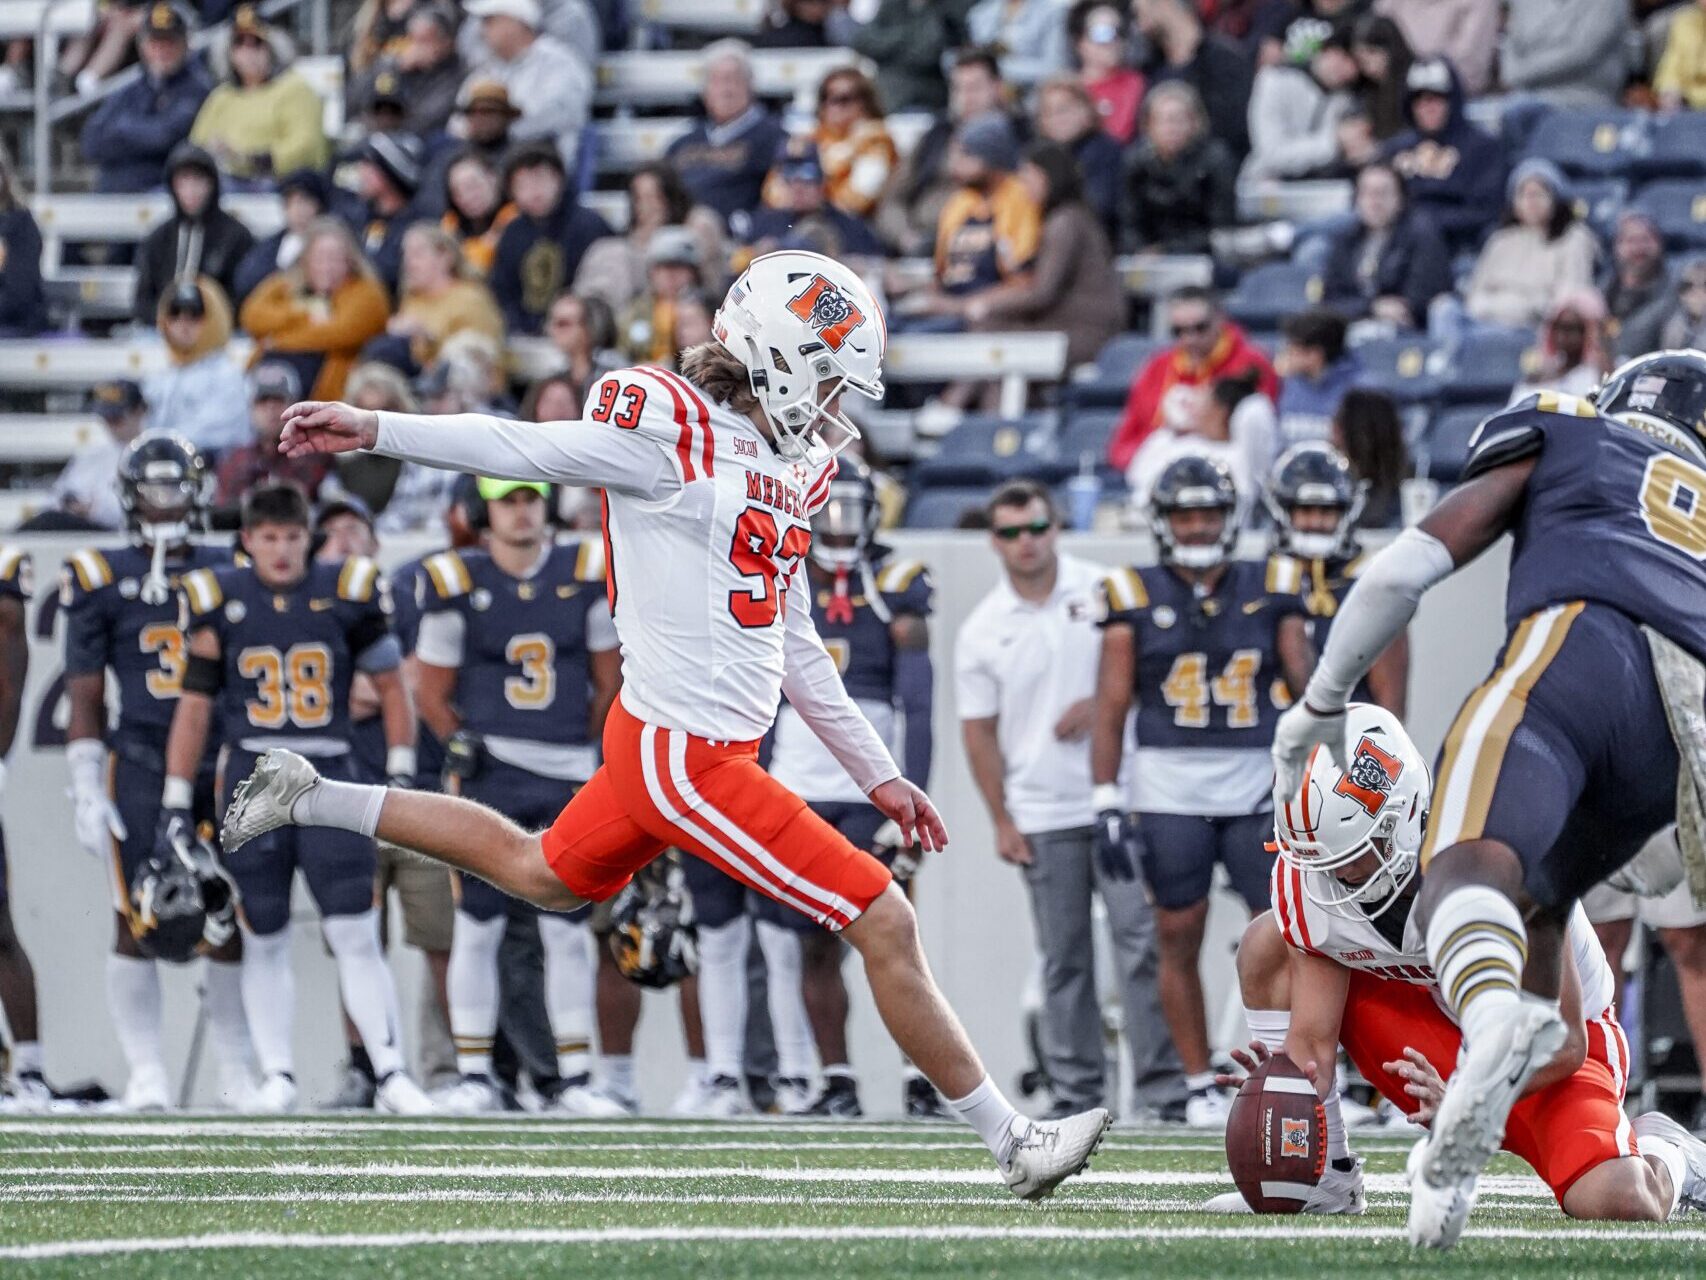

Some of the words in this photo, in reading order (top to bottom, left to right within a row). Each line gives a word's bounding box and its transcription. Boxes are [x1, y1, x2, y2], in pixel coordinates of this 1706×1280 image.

[591, 379, 647, 430] 93
[733, 436, 758, 458] SOCON
[745, 470, 808, 520] MERCE
[238, 642, 334, 729] 38
[504, 632, 557, 710] 3
[1161, 648, 1262, 728] 44
[1340, 949, 1376, 962] SOCON
[1363, 964, 1438, 981] MERC
[1265, 1107, 1273, 1135] TEAM
